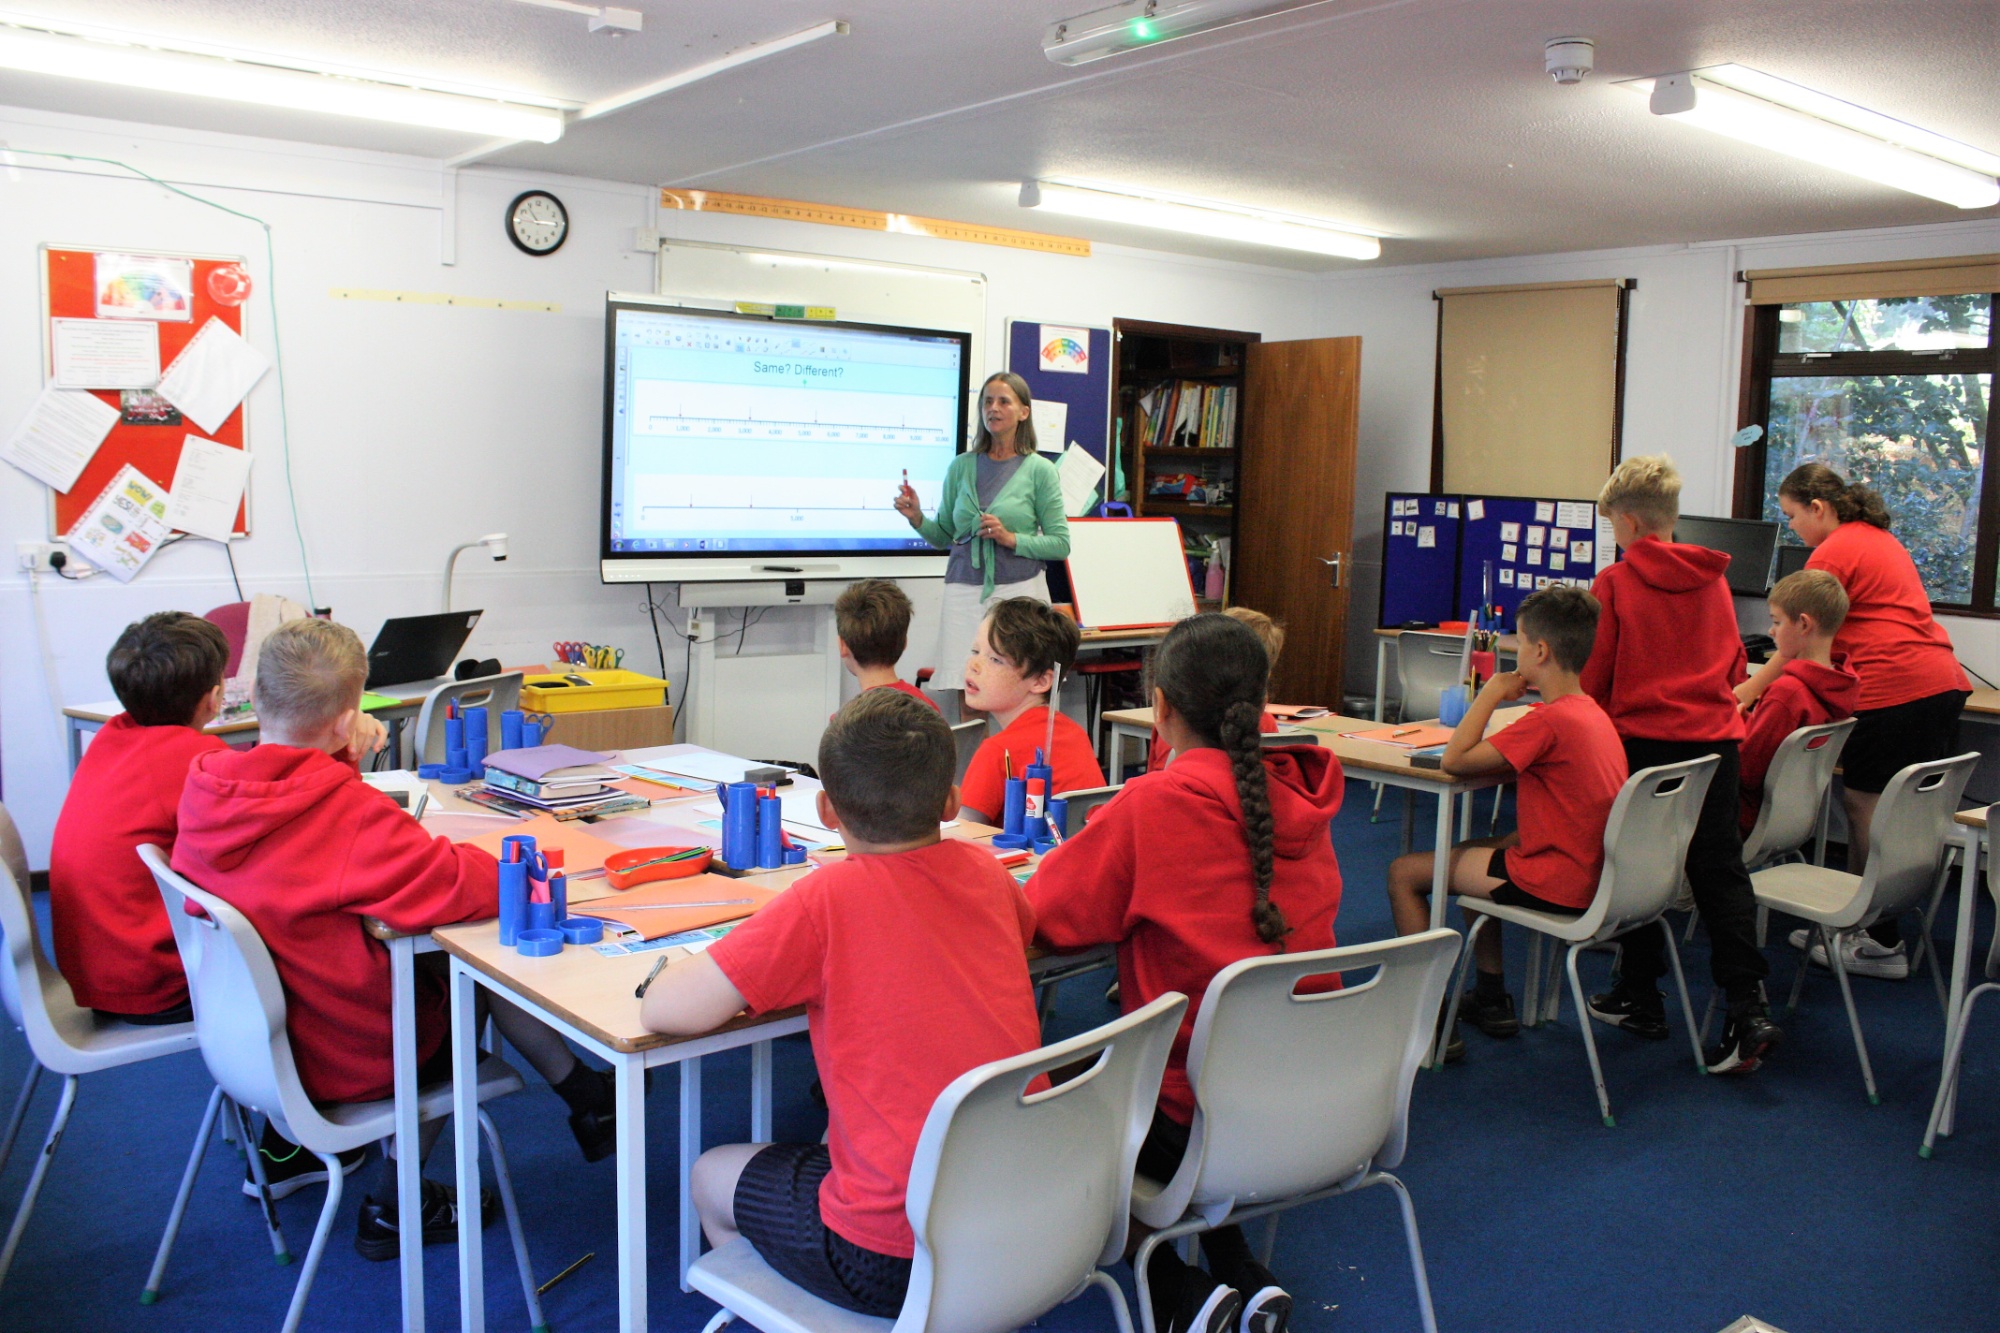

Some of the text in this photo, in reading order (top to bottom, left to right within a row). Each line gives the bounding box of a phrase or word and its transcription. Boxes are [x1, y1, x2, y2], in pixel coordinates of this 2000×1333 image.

[753, 360, 844, 378] Same? Different?
[127, 479, 154, 500] WOW!
